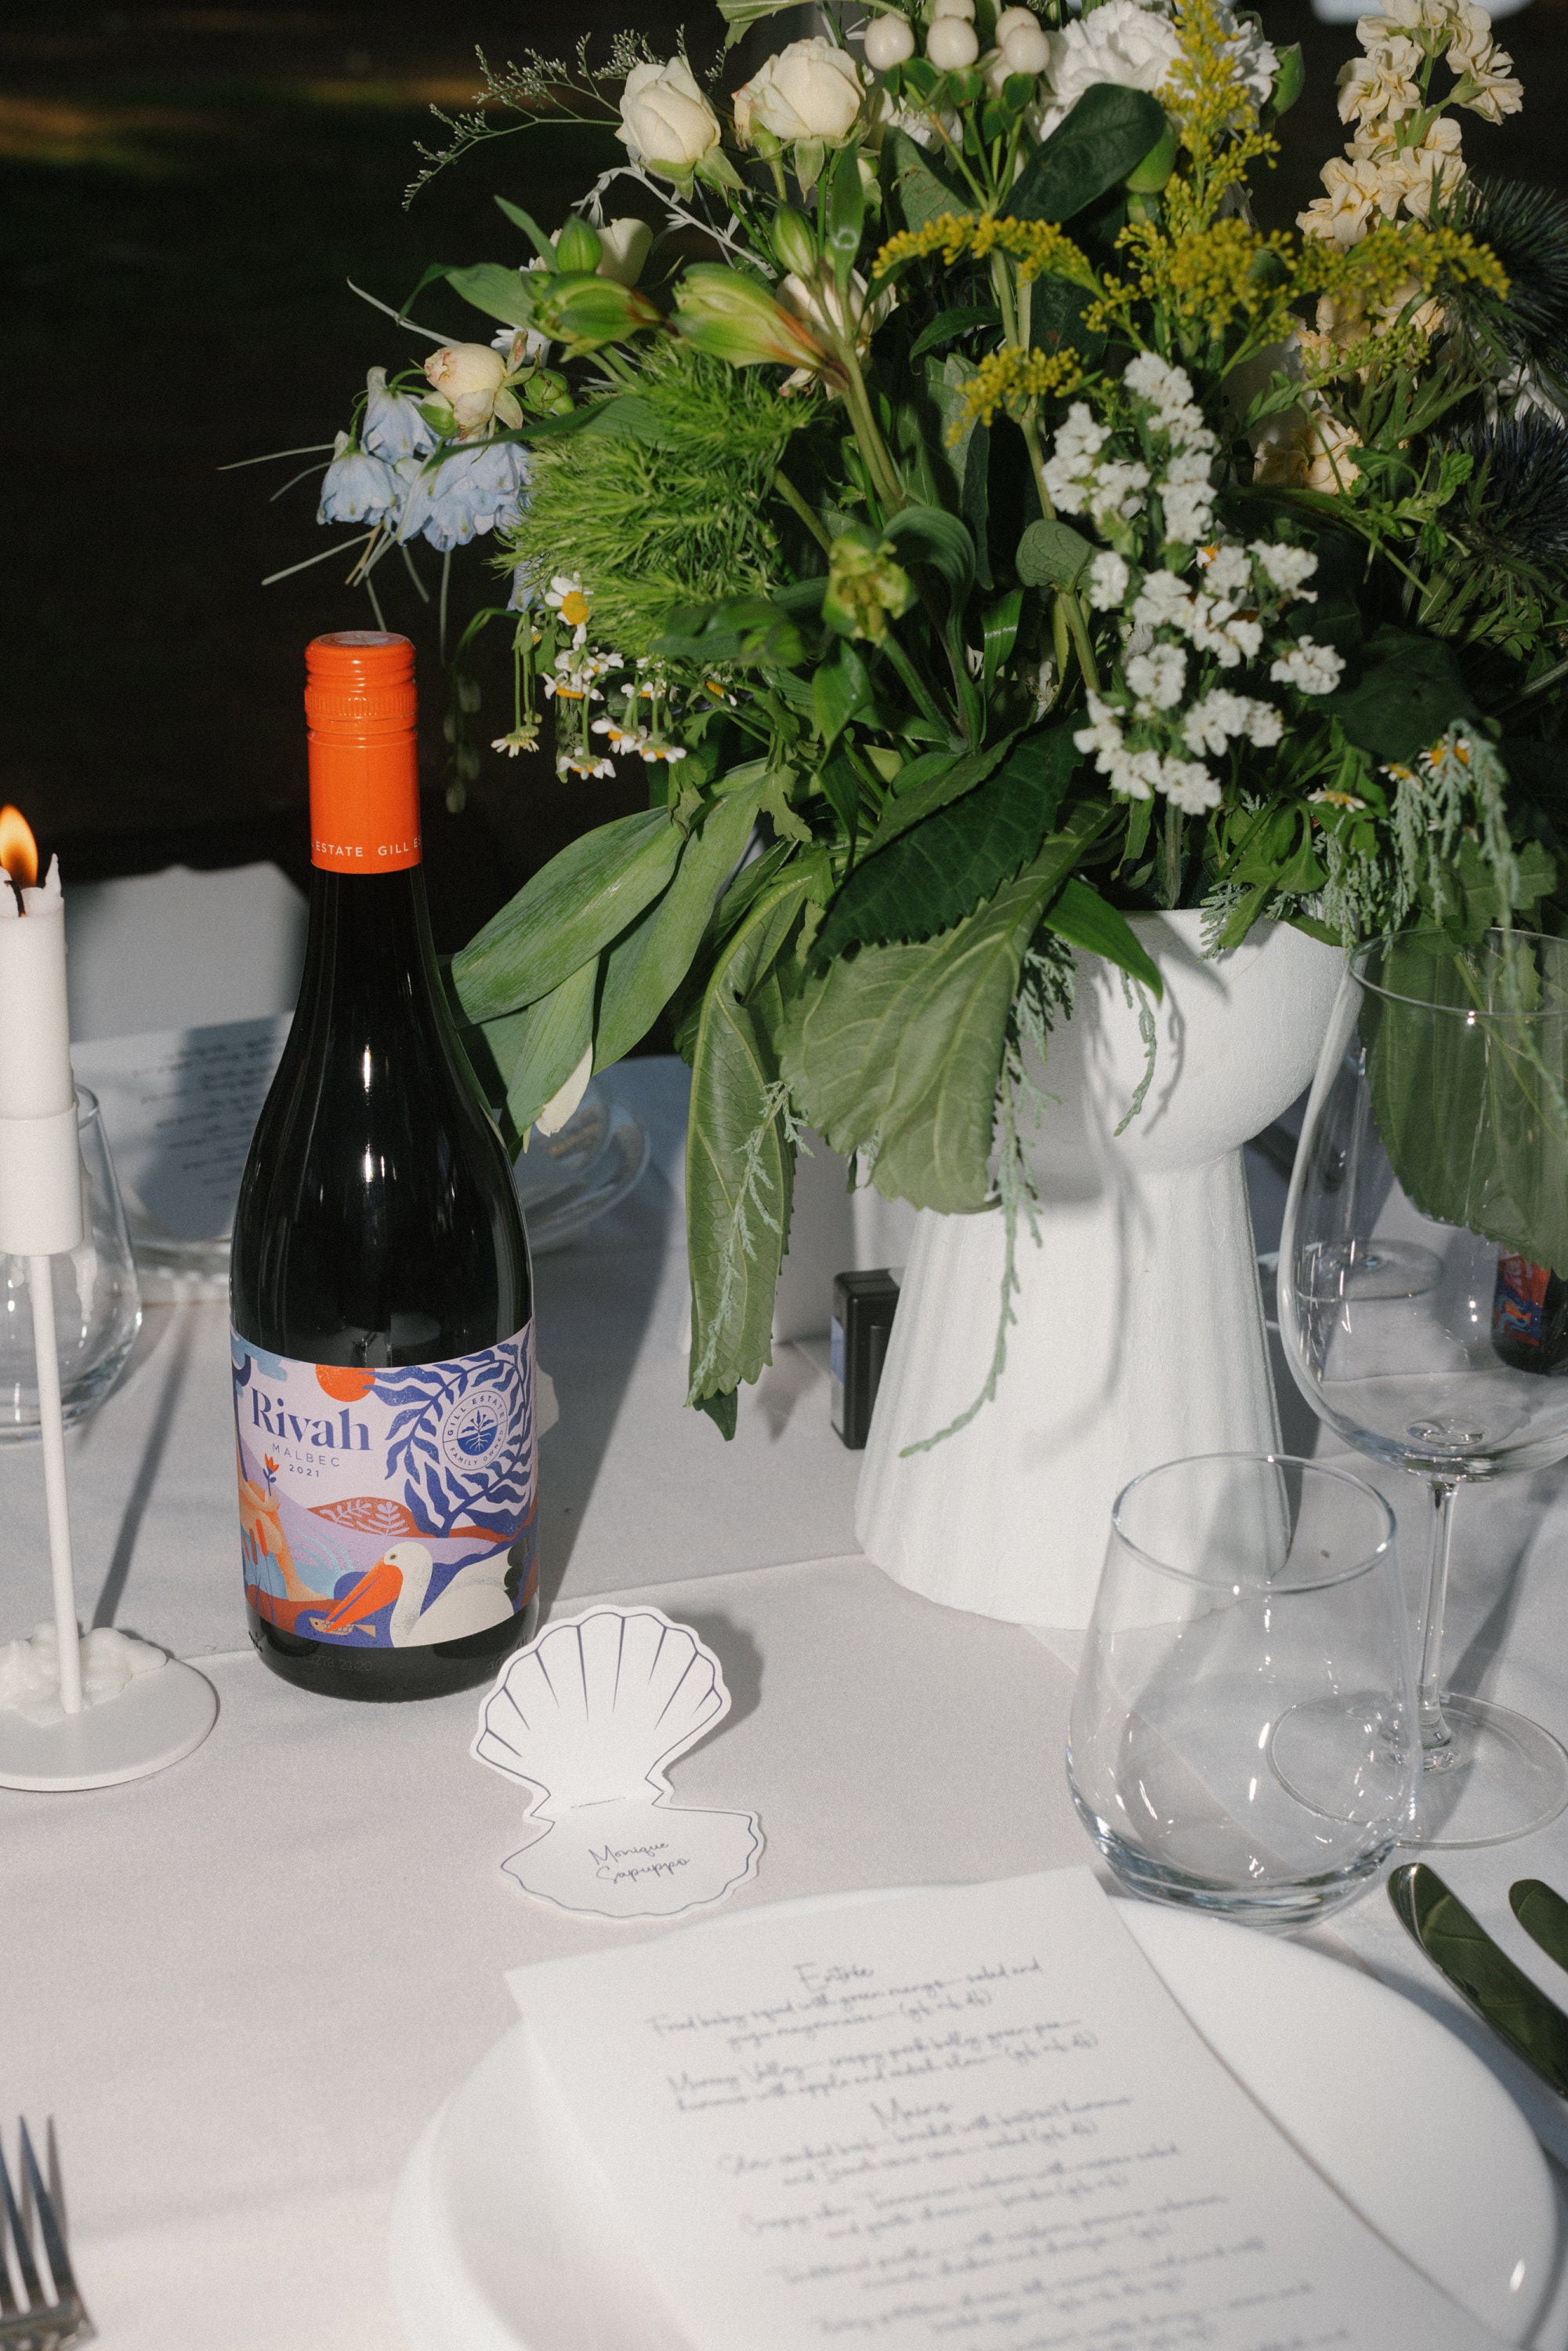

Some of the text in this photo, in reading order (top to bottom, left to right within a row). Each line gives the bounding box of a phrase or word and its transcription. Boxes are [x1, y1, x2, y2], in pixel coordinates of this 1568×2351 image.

[316, 840, 364, 857] ESTATE
[378, 842, 409, 857] GILL
[250, 1386, 374, 1451] Rivah
[447, 1395, 505, 1436] GILL ESTATE
[272, 1443, 340, 1467] MALBEC
[451, 1430, 503, 1466] FAMILY OWNED
[289, 1464, 320, 1477] 2021
[588, 1842, 669, 1865] Monique
